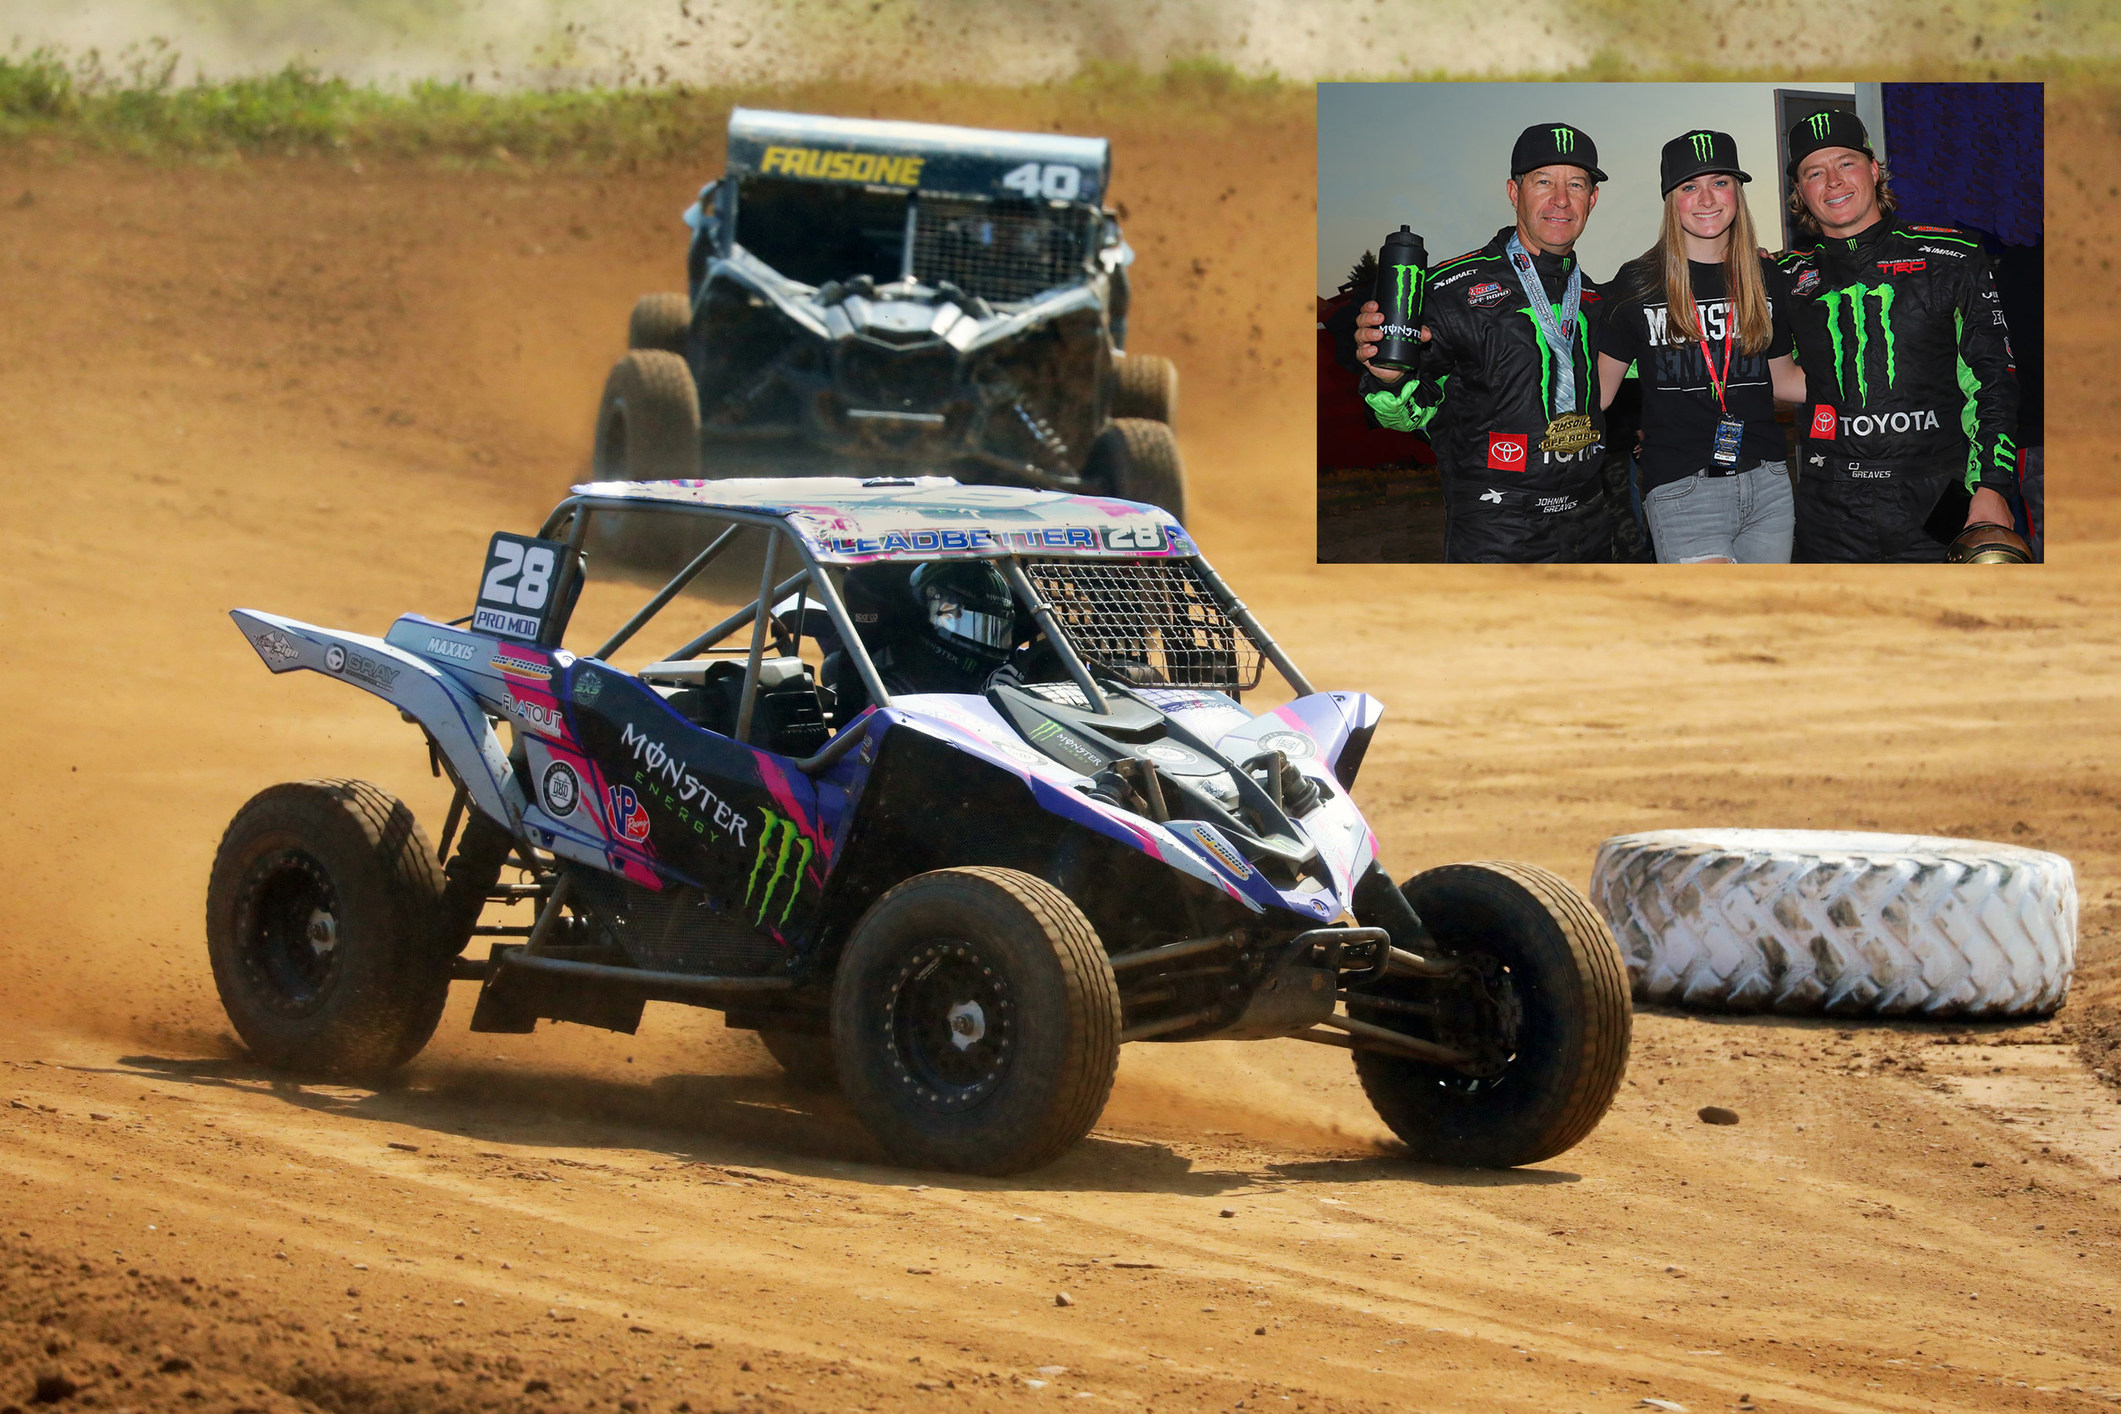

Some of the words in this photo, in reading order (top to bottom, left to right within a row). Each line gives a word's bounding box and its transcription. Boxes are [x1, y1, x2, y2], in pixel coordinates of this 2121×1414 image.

[760, 147, 925, 186] FAUSONE
[1003, 163, 1082, 200] 40
[1931, 247, 1967, 259] IMPACT
[1445, 269, 1478, 285] IMPACT
[1876, 261, 1927, 276] TRD
[1551, 418, 1588, 433] AMSOIL
[1839, 410, 1940, 437] TOYOTA
[1851, 470, 1891, 479] GREAVES
[1535, 495, 1569, 507] JOHNNY
[1543, 500, 1578, 513] GREAVES
[831, 526, 1094, 554] LEADBETTER
[1108, 523, 1162, 549] 28
[481, 539, 555, 609] 28
[477, 611, 505, 630] PRO
[508, 617, 537, 636] MOD
[426, 637, 476, 661] MAXXIS
[346, 652, 400, 684] GRAY
[502, 693, 562, 729] FLATOUT
[1056, 733, 1102, 767] MONSTER
[621, 723, 749, 848] MONSTER
[608, 785, 638, 839] VP
[633, 770, 719, 844] ENERGY
